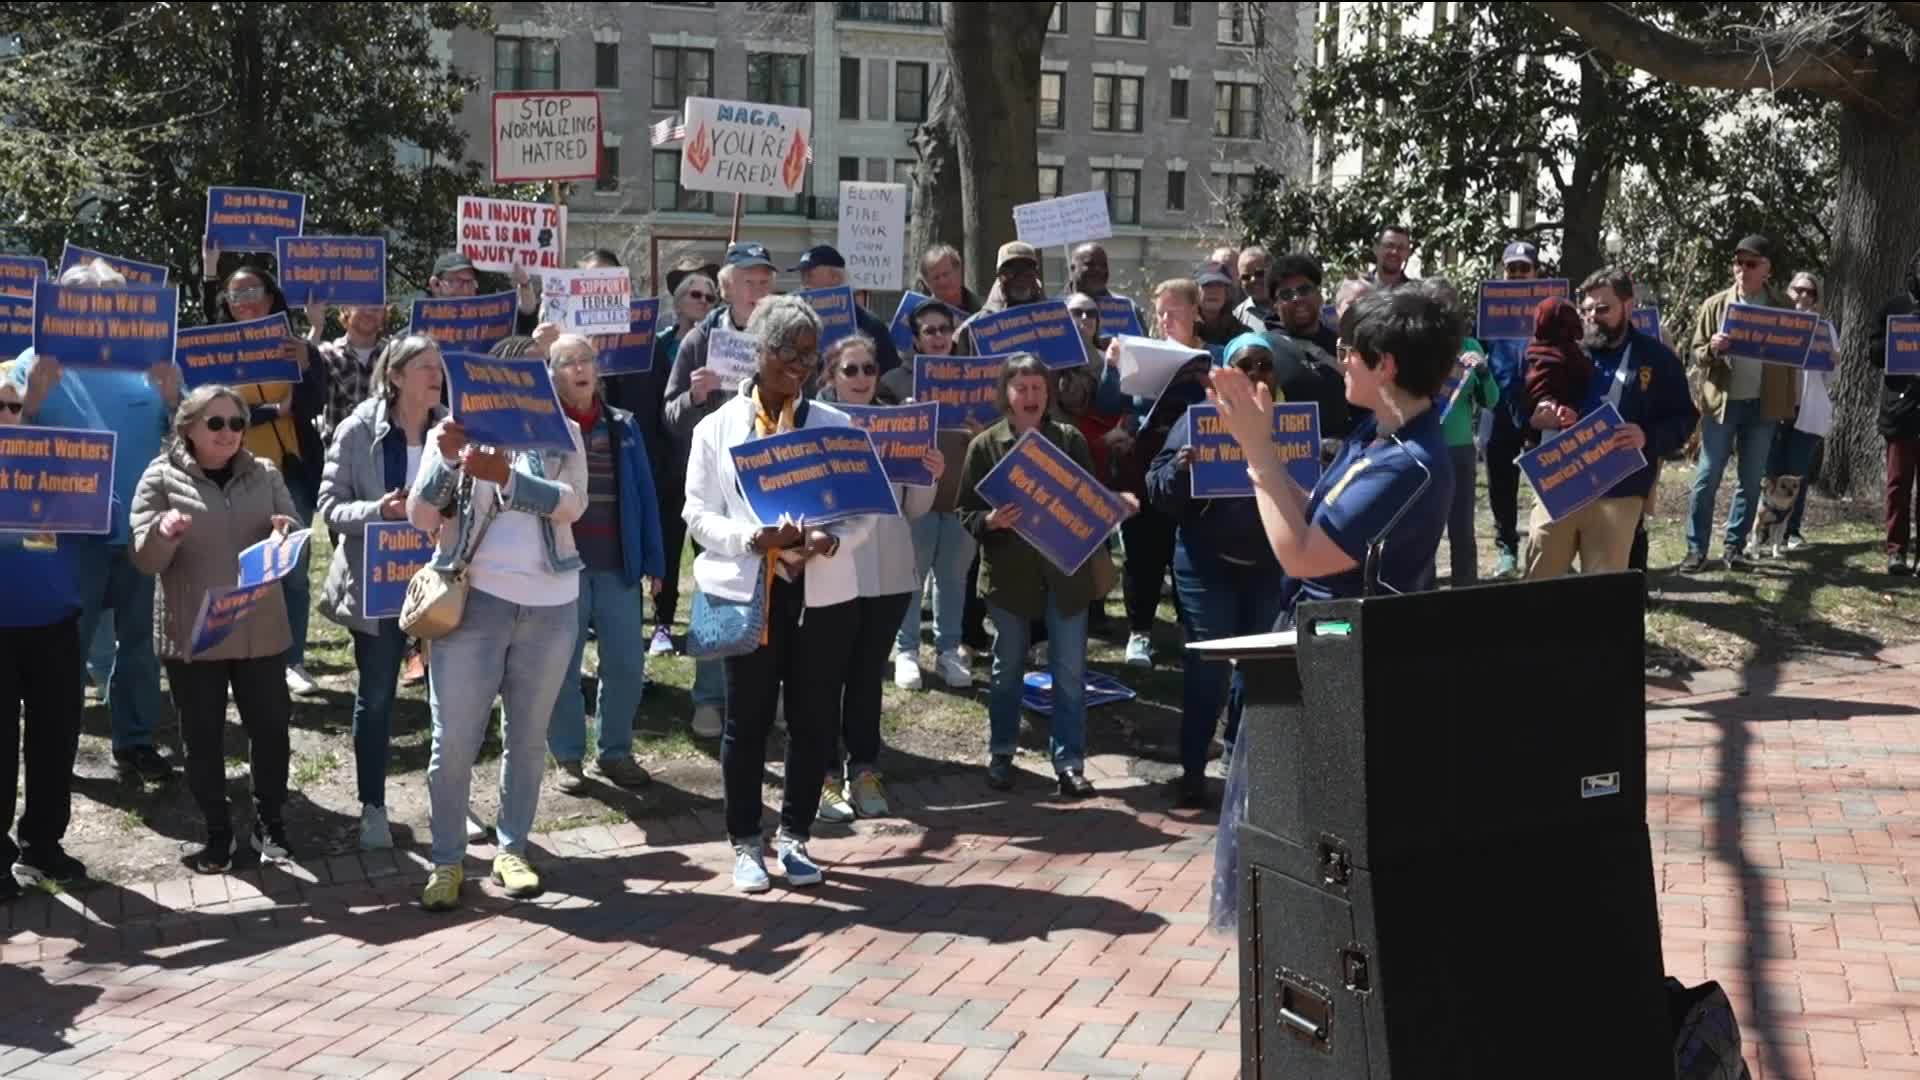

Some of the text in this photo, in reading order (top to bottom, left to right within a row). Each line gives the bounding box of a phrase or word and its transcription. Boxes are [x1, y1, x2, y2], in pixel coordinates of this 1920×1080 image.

[520, 98, 572, 120] STOP
[500, 116, 596, 141] NORMALIZING
[522, 139, 587, 164] HATRED
[711, 128, 785, 159] YOU'RE
[716, 160, 777, 186] FIRED!
[463, 202, 559, 227] AN INJURY TO
[846, 205, 881, 222] FIRE
[462, 225, 531, 244] ONE IS AN
[287, 242, 320, 259] Public
[321, 242, 363, 259] Service
[462, 244, 514, 263] INJURY
[518, 249, 538, 266] TO
[579, 279, 627, 295] SUPPORT
[58, 291, 157, 313] Stop the War on
[582, 295, 624, 309] FEDERAL
[868, 414, 914, 433] Service
[919, 409, 929, 431] is
[1197, 414, 1312, 434] STAN FIGHT
[55, 437, 110, 461] Workers
[735, 449, 773, 473] Proud
[14, 468, 33, 491] for
[758, 462, 829, 492] Government
[378, 529, 422, 552] Public
[373, 566, 382, 583] a
